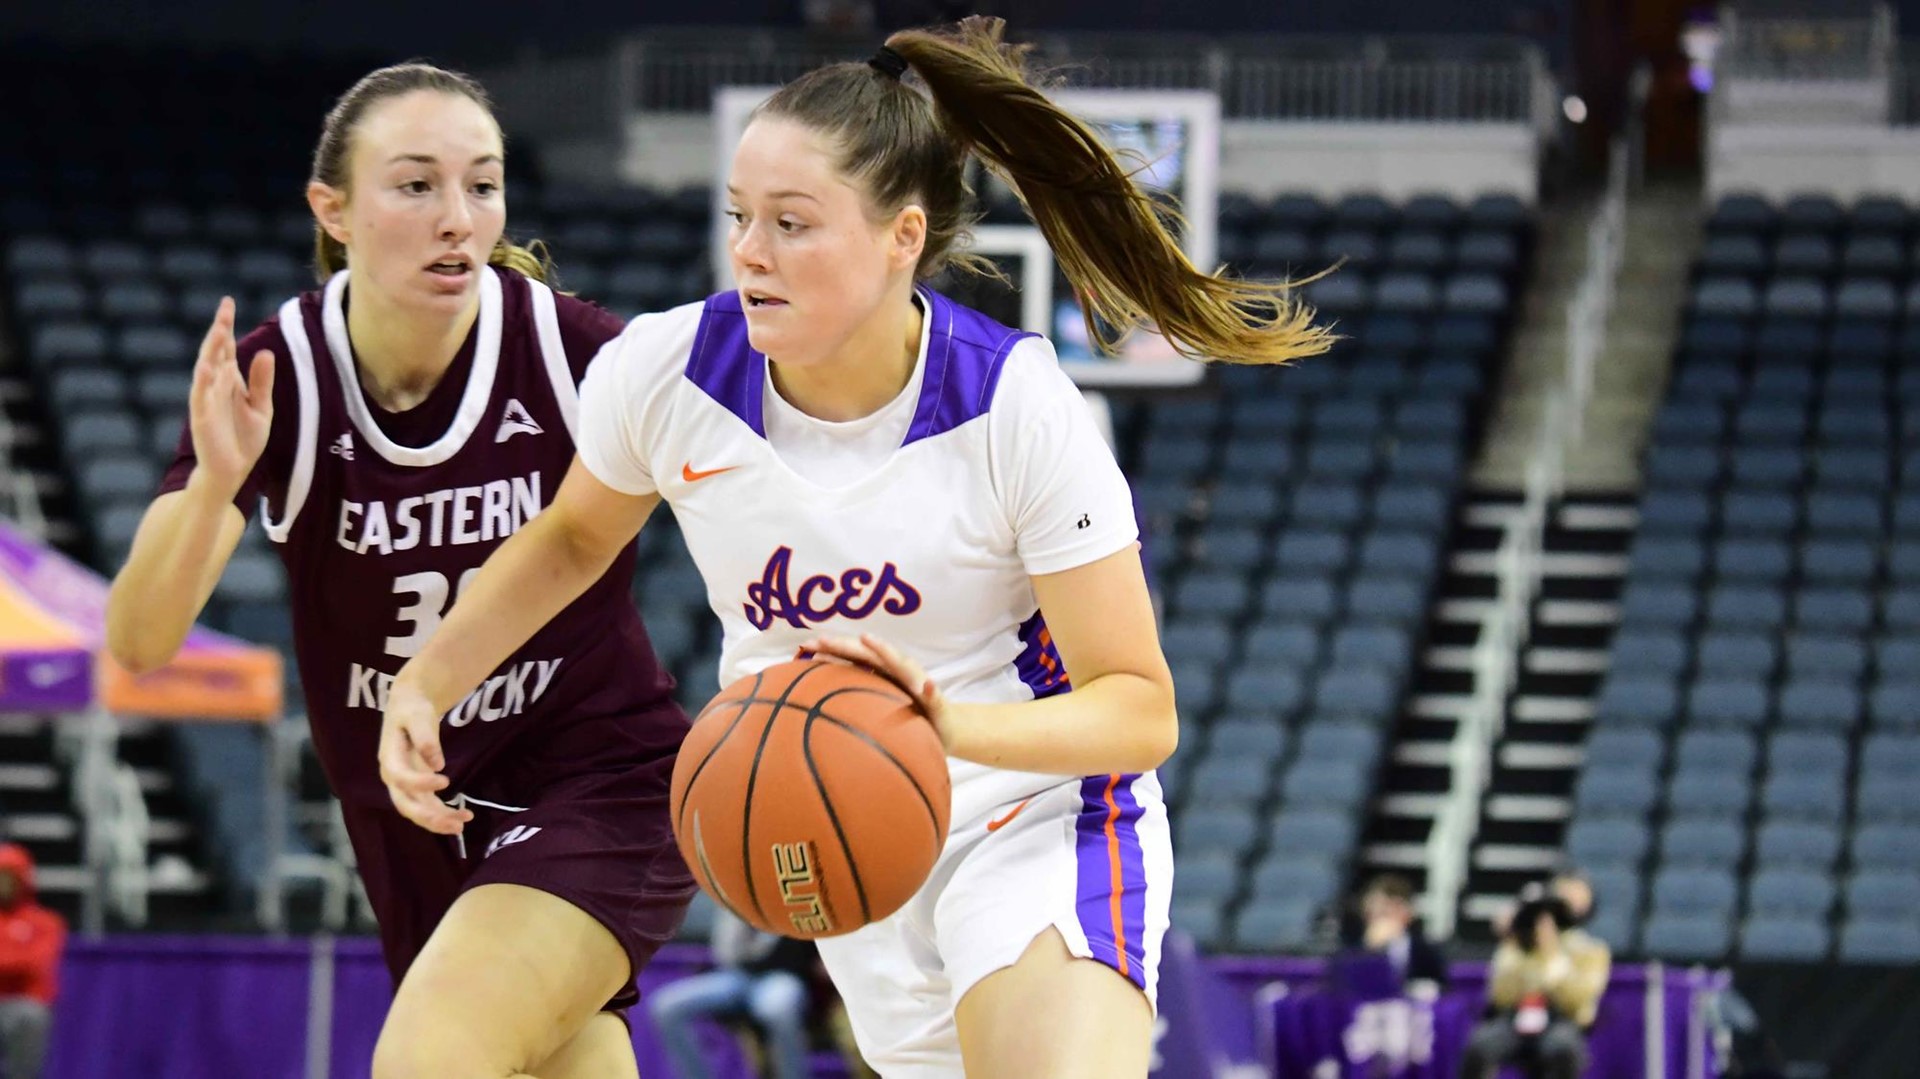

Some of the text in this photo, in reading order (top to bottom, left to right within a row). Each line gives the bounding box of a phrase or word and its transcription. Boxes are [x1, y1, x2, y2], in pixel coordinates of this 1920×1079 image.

[336, 471, 542, 556] EASTERN
[384, 567, 482, 659] 3
[347, 658, 564, 728] KEUCKY
[771, 842, 834, 933] ELITE
